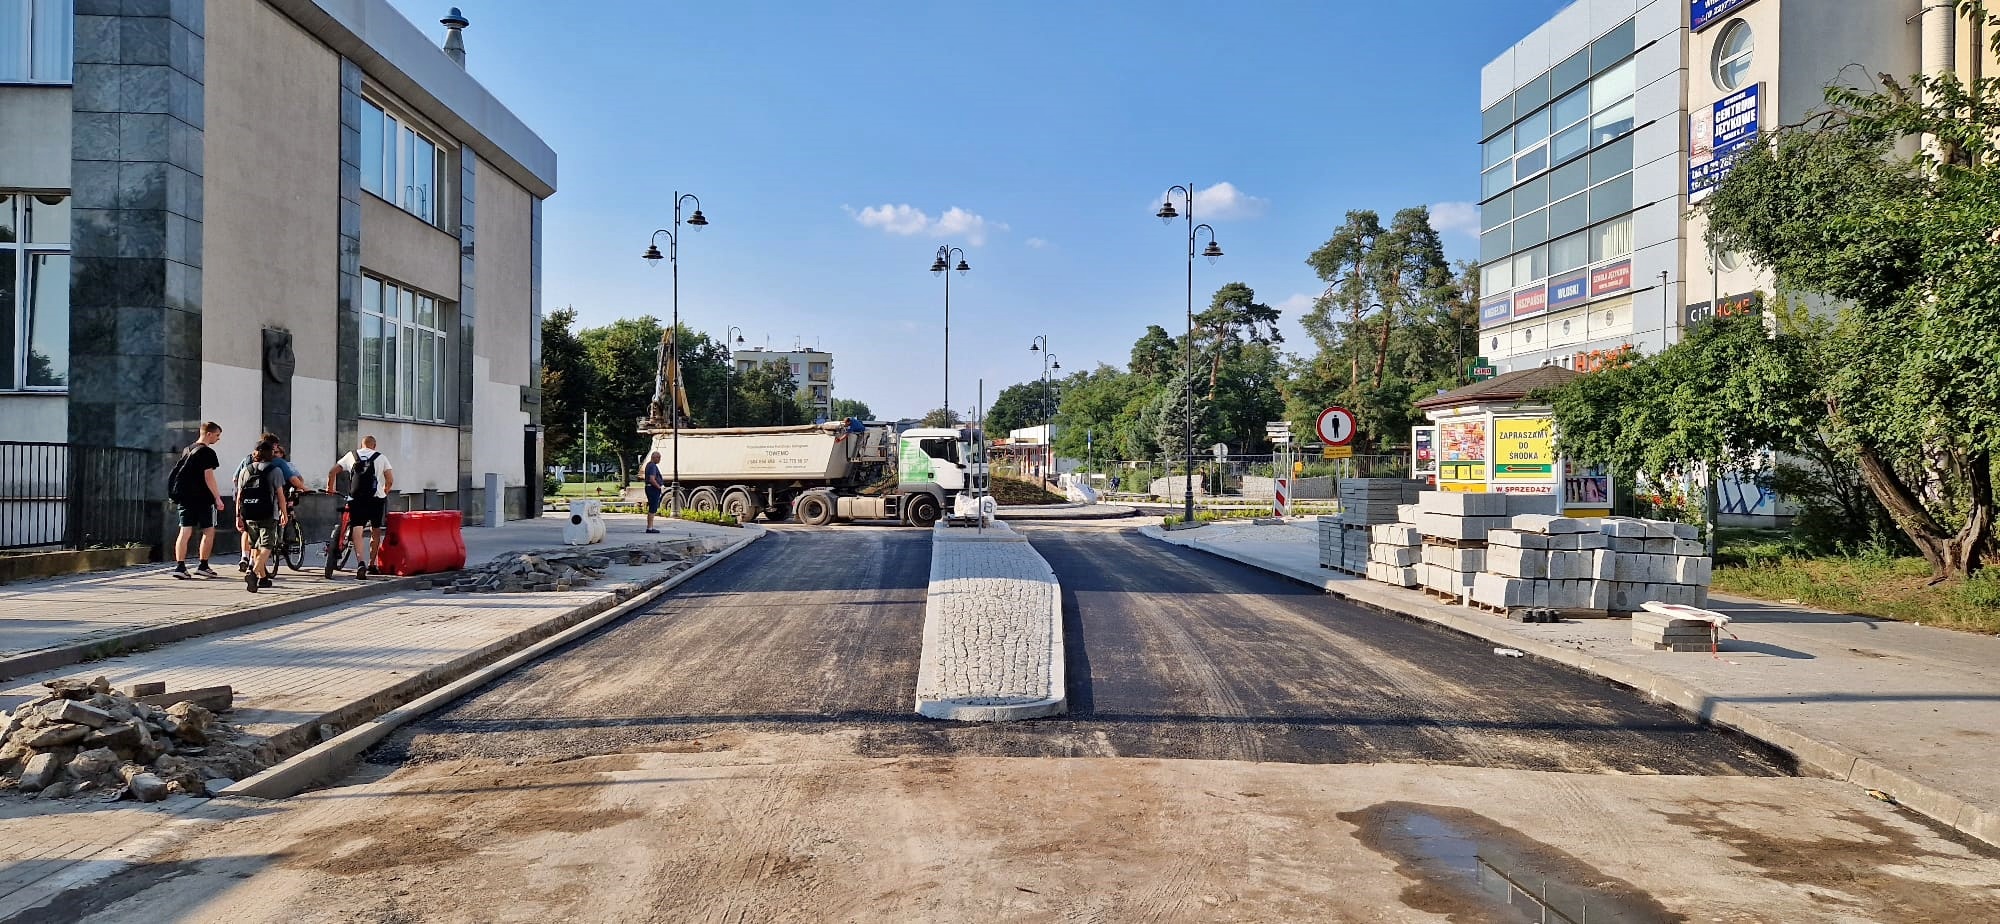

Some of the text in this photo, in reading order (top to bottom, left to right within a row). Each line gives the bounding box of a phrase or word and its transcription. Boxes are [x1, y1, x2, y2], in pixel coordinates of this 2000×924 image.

[1715, 95, 1755, 124] CENTRUM
[1715, 108, 1756, 137] JĘZYKOWE
[1558, 283, 1579, 299] WŁOSKI
[1499, 431, 1548, 440] ZAPRASZAMY
[1518, 441, 1529, 449] DO
[1509, 450, 1539, 460] ŚRODKA
